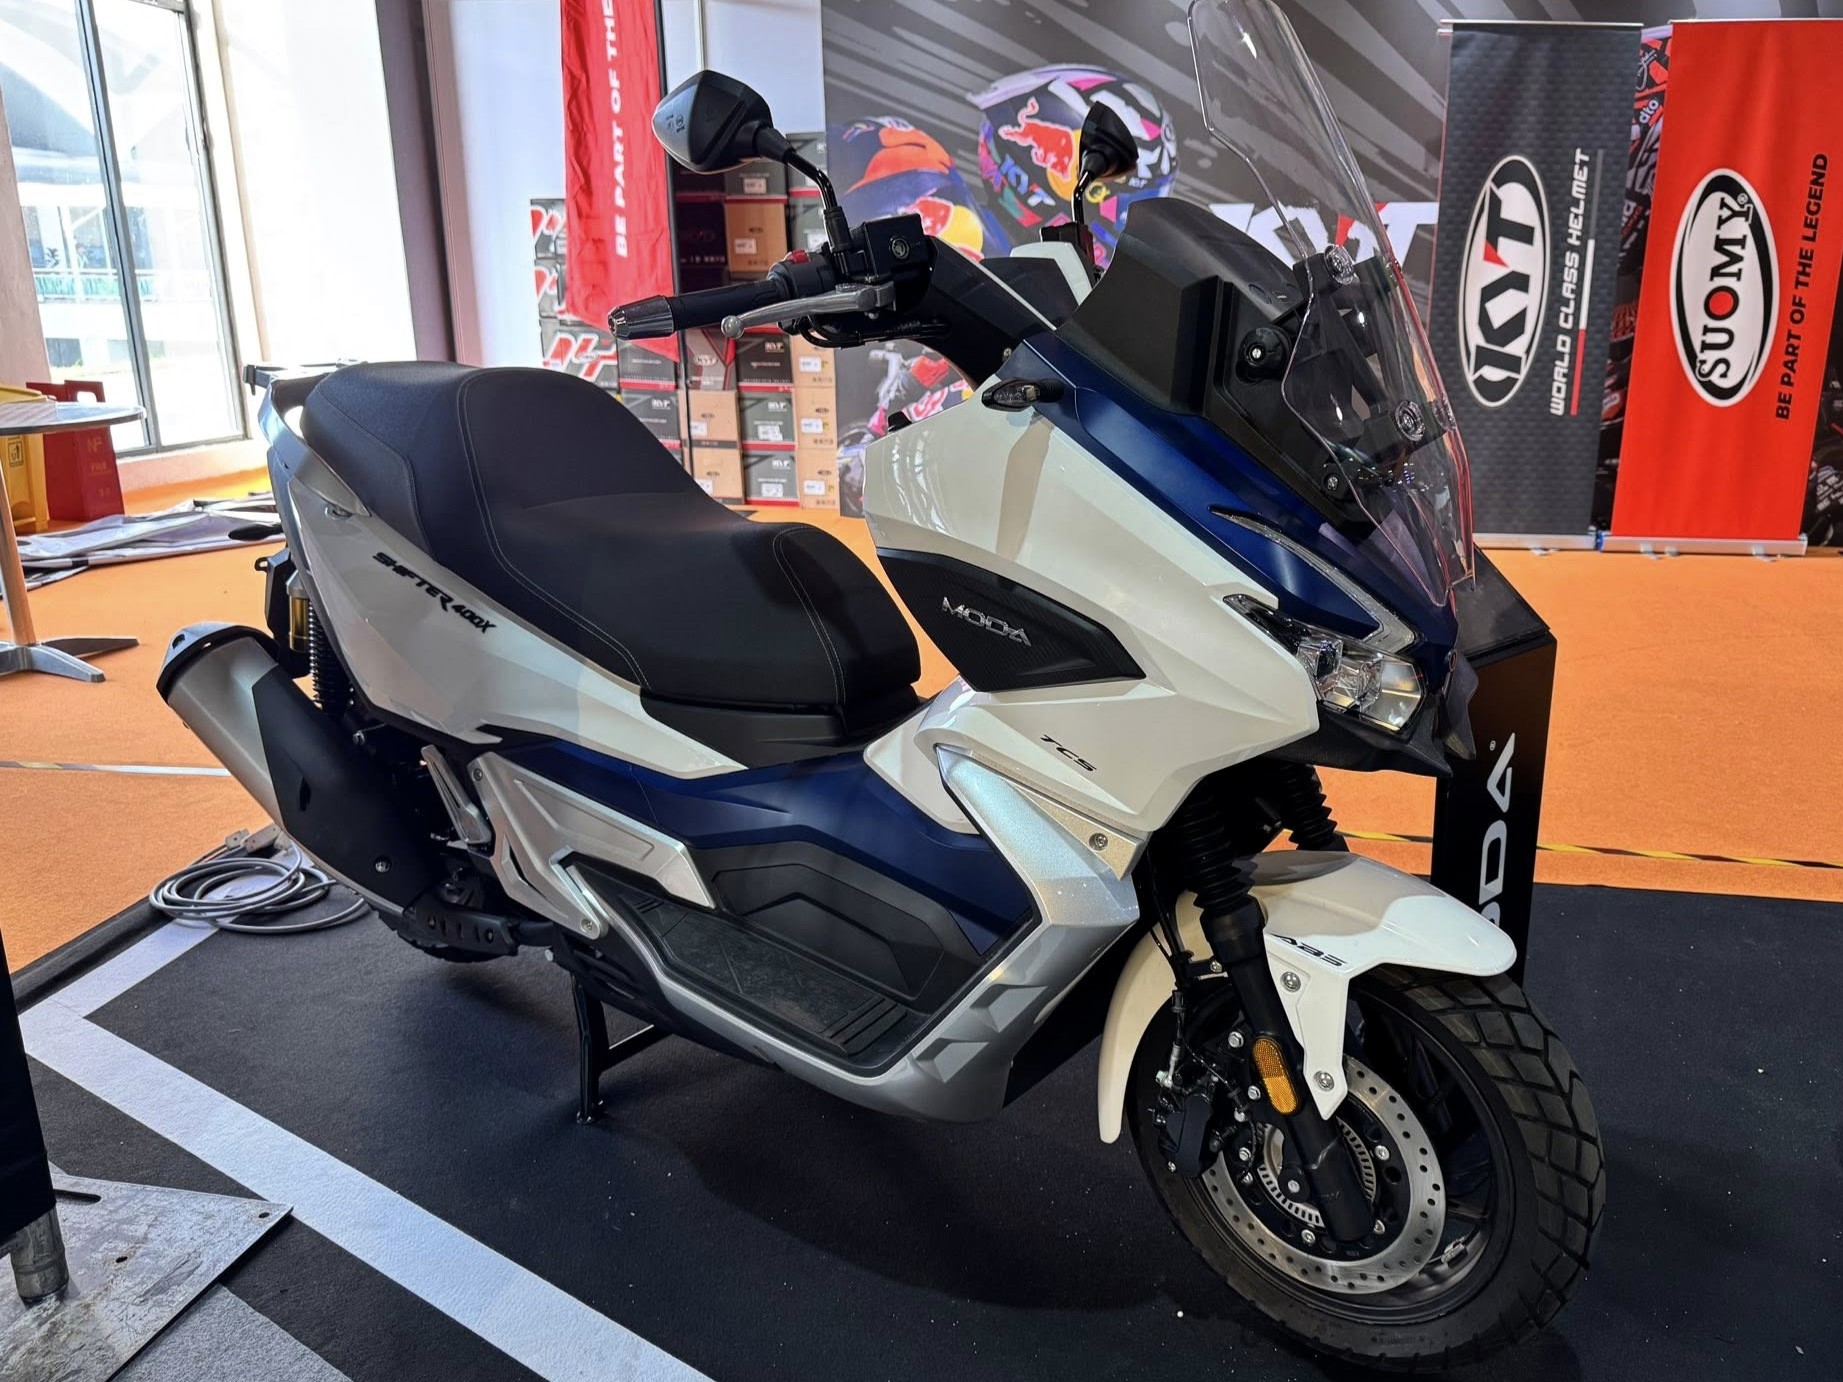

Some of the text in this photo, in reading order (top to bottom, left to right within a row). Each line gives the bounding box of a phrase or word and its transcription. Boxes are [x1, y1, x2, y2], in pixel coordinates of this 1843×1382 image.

[601, 0, 628, 258] BE PART OF THE
[1470, 179, 1536, 382] KYT
[1550, 147, 1590, 416] WORLD CLASS HELMET
[1695, 196, 1753, 382] SUOMY
[1775, 153, 1828, 420] BE PART OF THE LEGEND
[451, 604, 497, 634] 400X
[941, 596, 1032, 647] MODA
[1040, 734, 1098, 772] TCS
[1268, 933, 1348, 967] ABS
